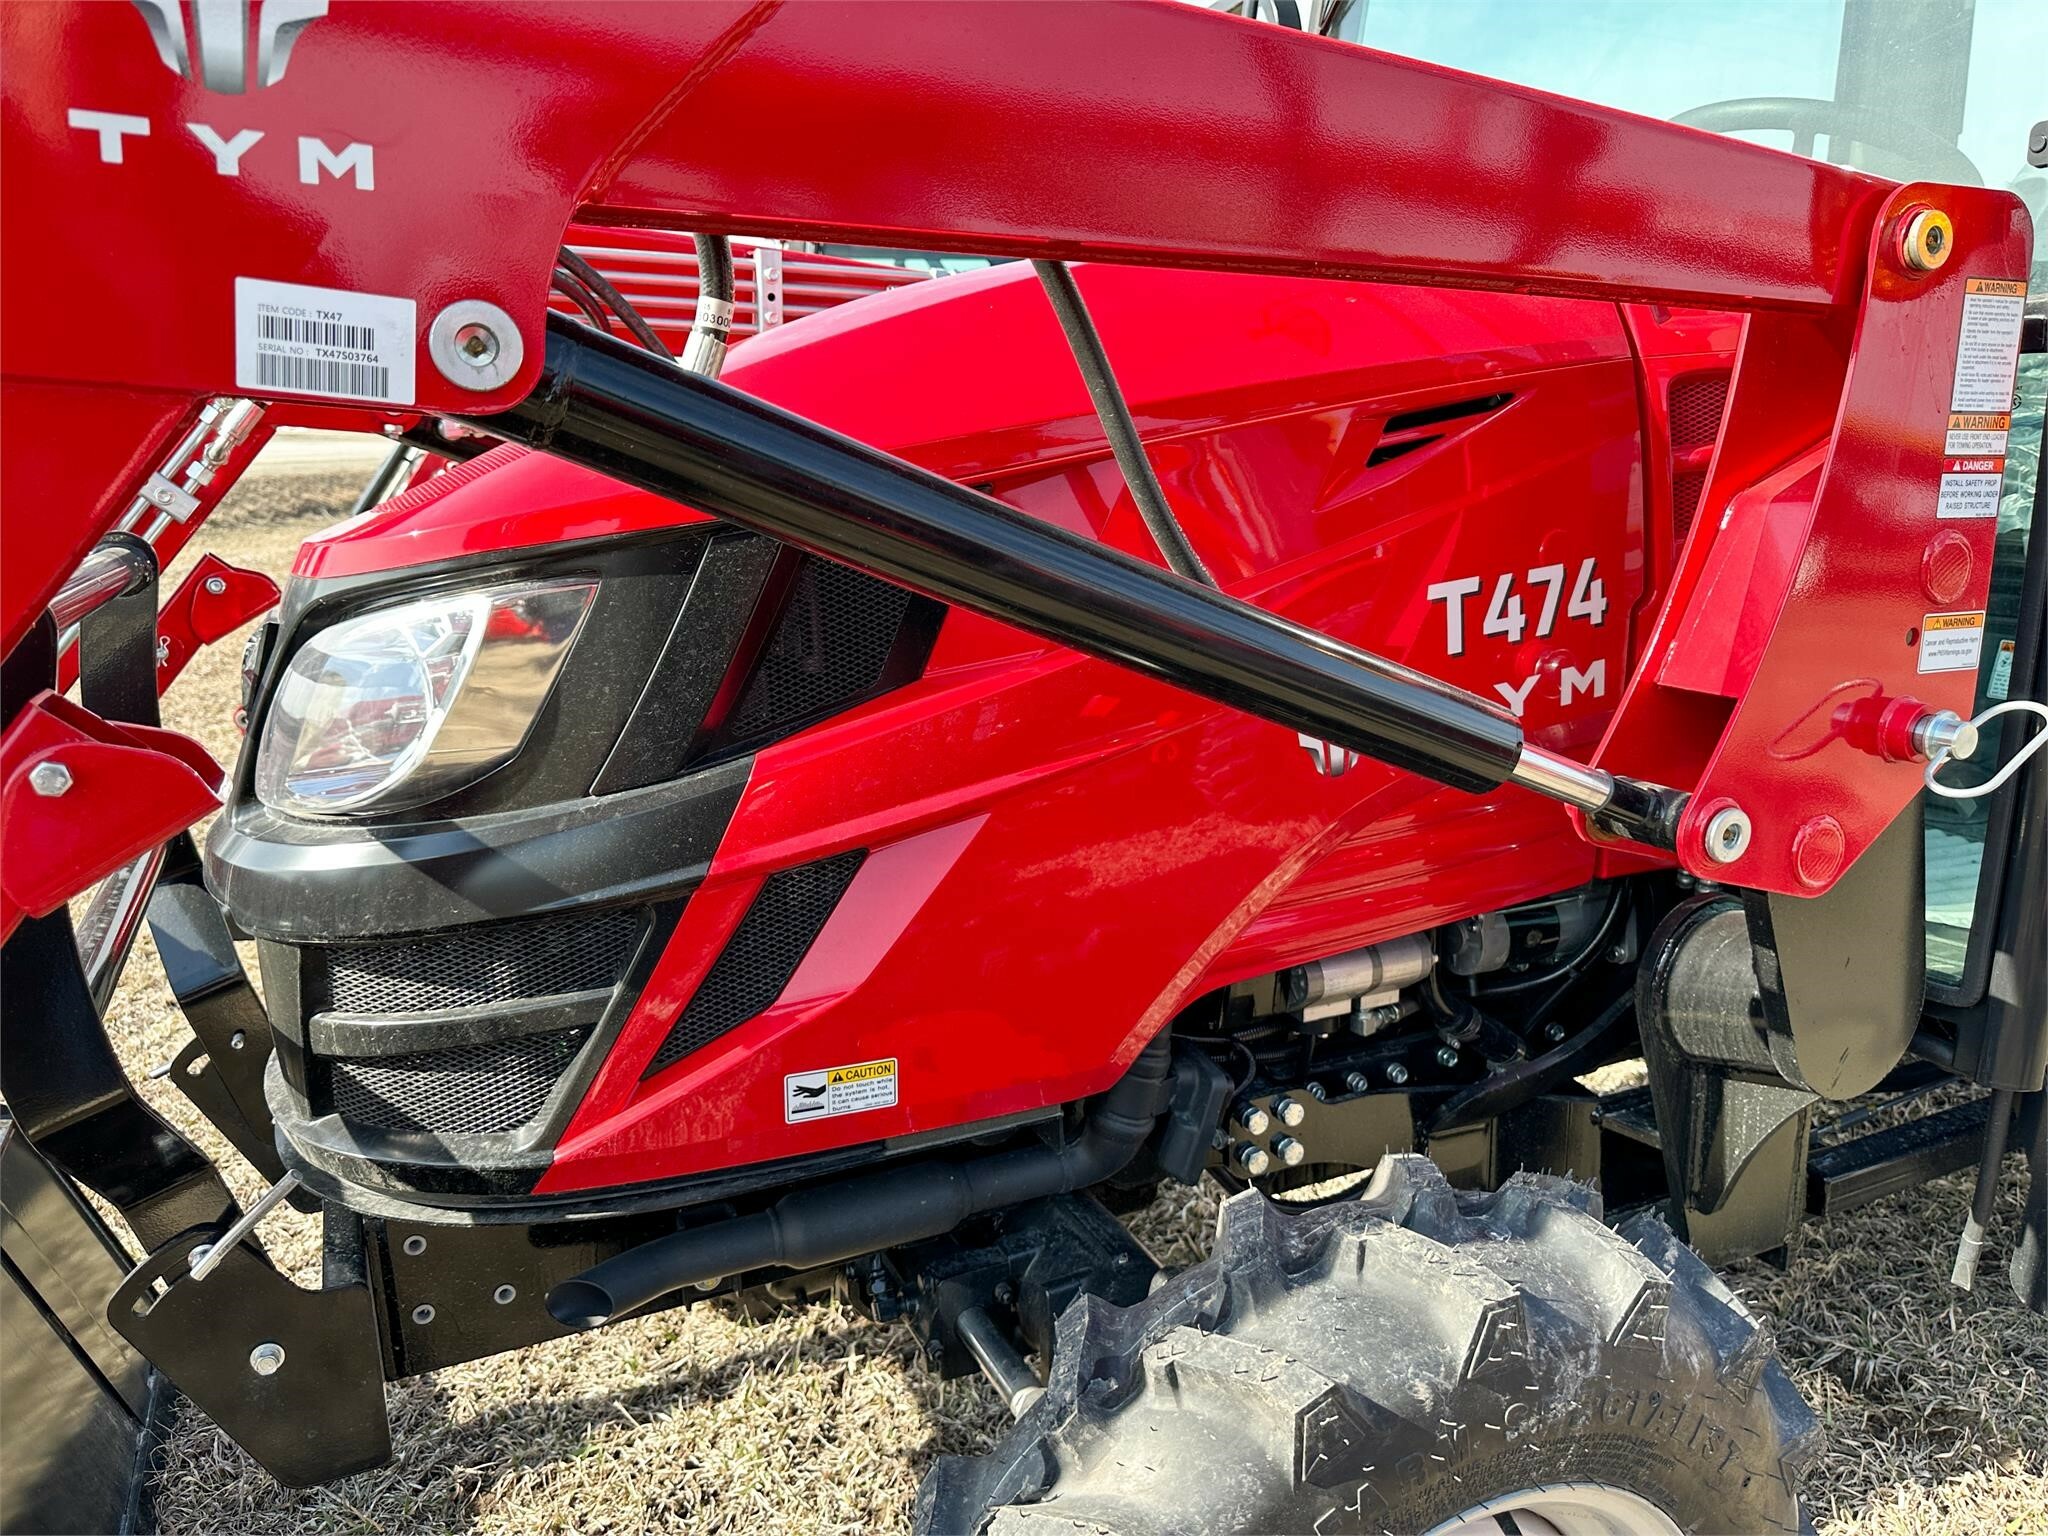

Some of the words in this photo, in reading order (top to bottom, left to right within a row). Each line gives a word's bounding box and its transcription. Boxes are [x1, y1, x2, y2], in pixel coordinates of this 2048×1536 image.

[67, 108, 375, 191] TYM
[1984, 282, 2018, 294] WARNING
[257, 303, 279, 313] ITEM
[282, 306, 306, 317] CODE
[316, 310, 342, 321] TX47
[258, 342, 286, 353] SERIAL
[315, 347, 379, 363] TX47S03764
[1963, 416, 2006, 429] WARNING
[1962, 461, 1994, 471] DANGER
[1945, 479, 1964, 487] INSTALL
[1965, 479, 1983, 487] SAFETY
[1984, 479, 1997, 487] PROP
[1945, 502, 1963, 510] RAISED
[1427, 557, 1608, 657] T474
[1942, 616, 1975, 628] WARNING
[1493, 658, 1606, 718] YM
[845, 1064, 891, 1081] CAUTION
[856, 1080, 875, 1088] touch
[845, 1088, 868, 1098] system
[871, 1091, 893, 1099] serious
